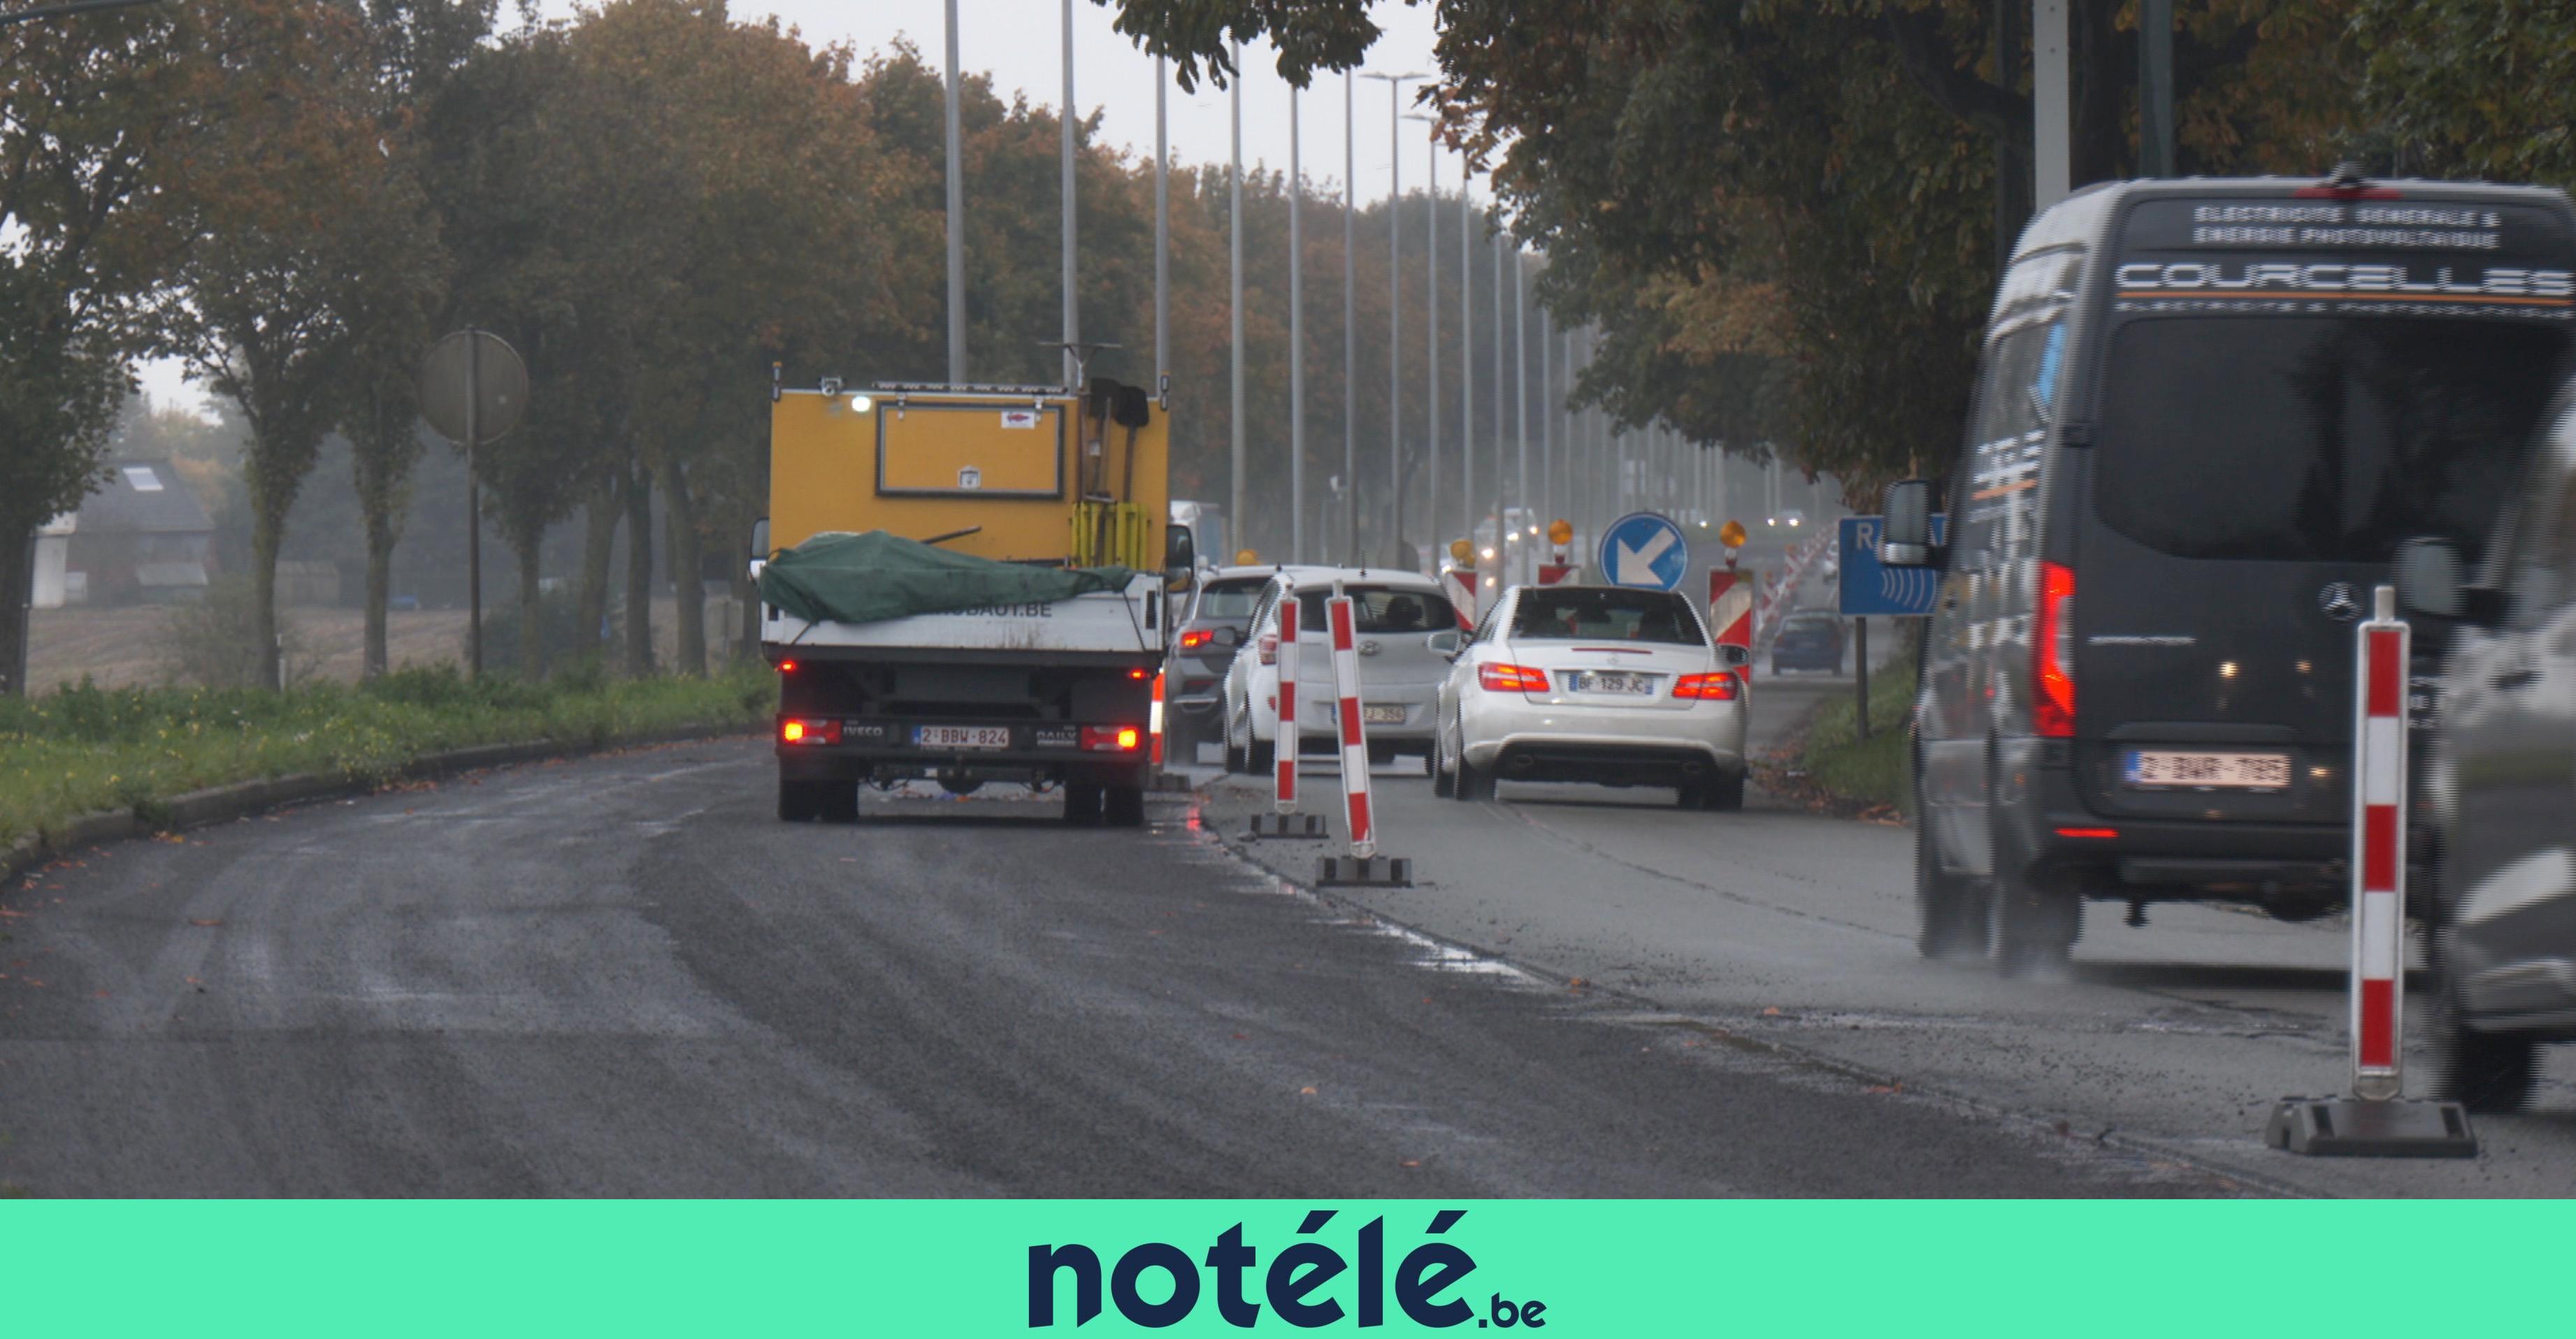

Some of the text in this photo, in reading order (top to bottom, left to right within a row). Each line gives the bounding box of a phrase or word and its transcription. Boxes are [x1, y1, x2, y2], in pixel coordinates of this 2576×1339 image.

[2192, 227, 2501, 249] ENERGIE PHOTOVOLTAIQUE
[2115, 263, 2575, 297] COURCELLES
[842, 726, 883, 736] IVECO
